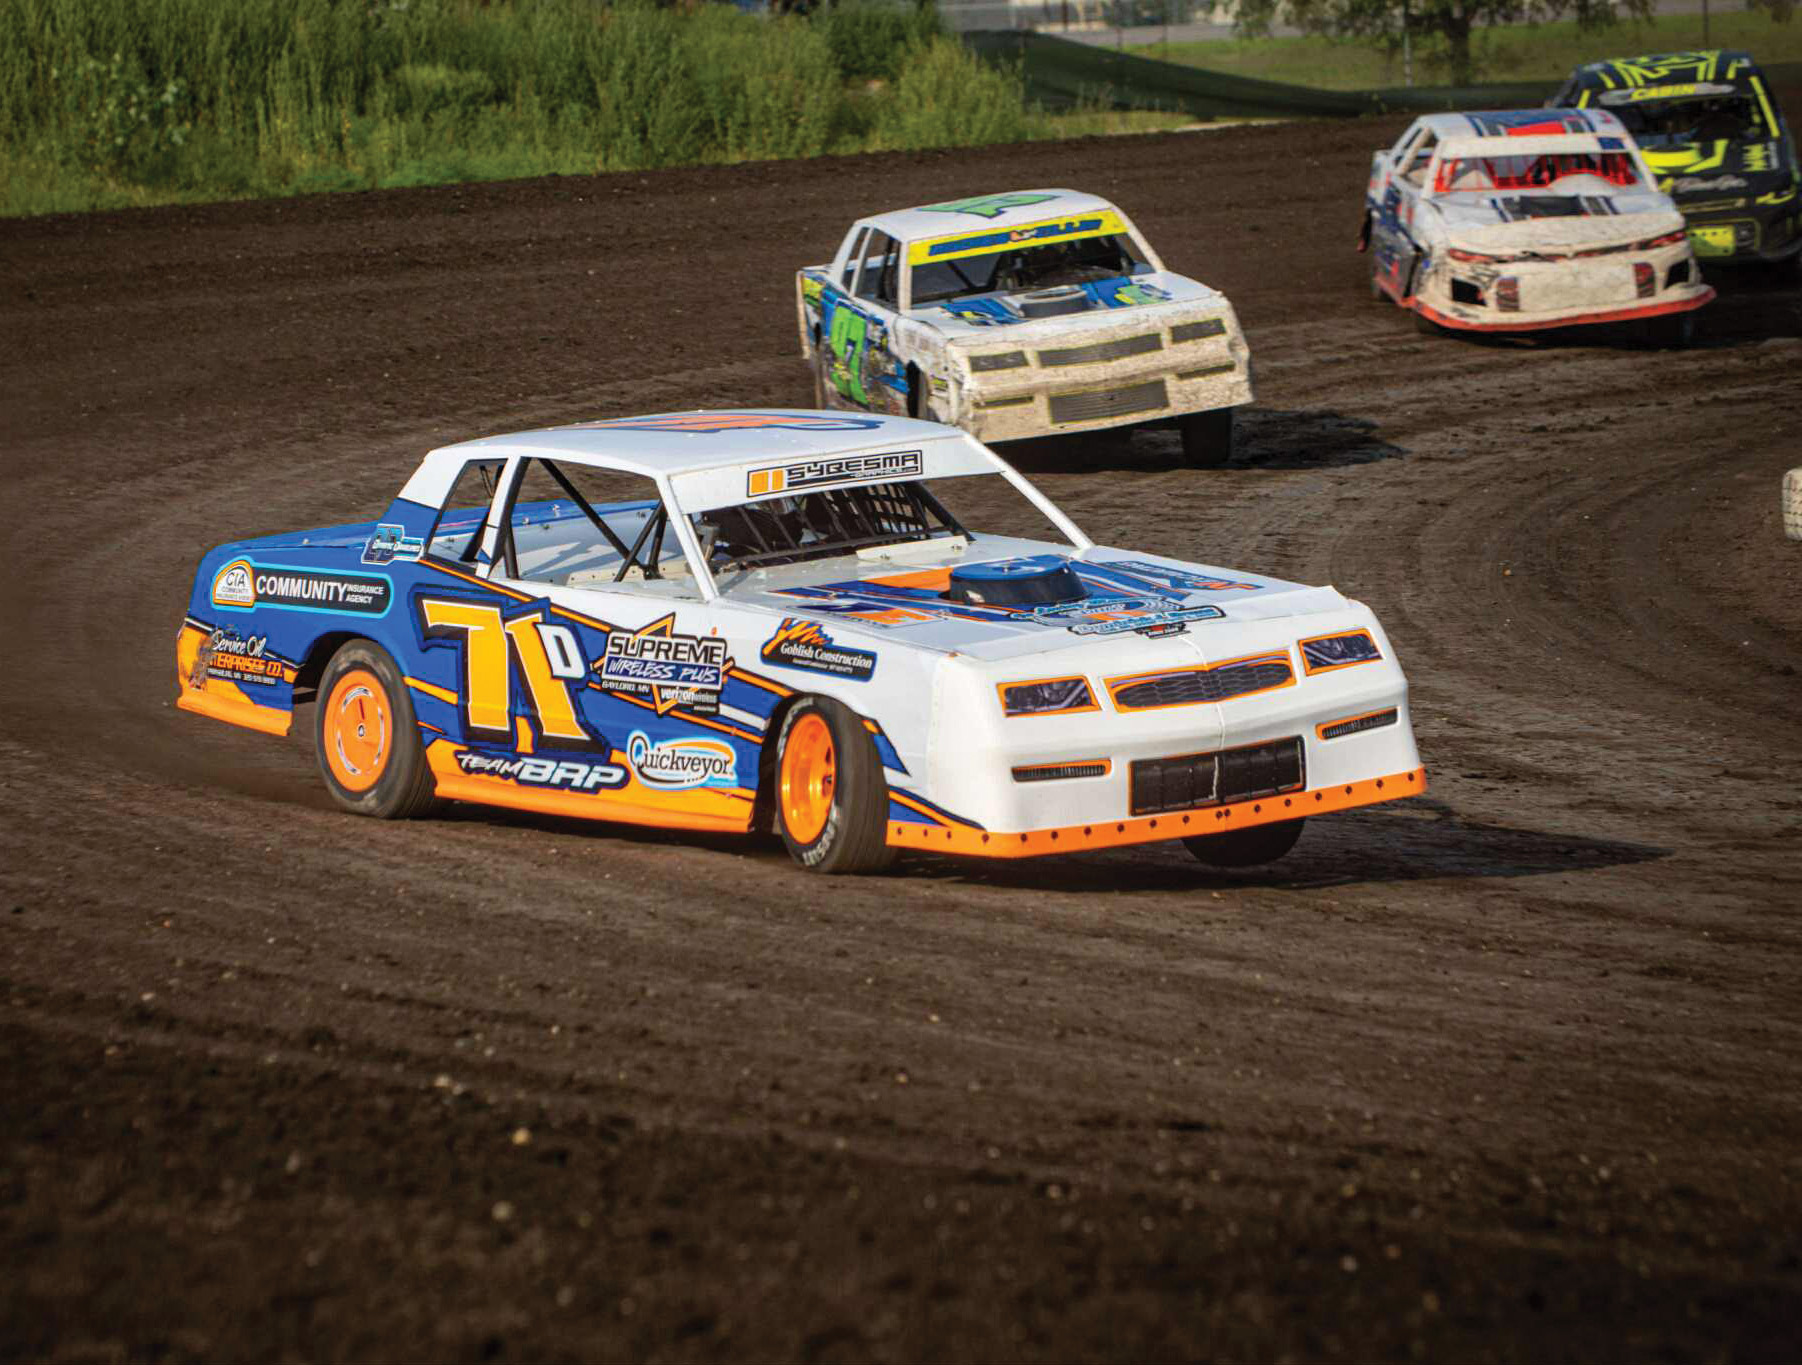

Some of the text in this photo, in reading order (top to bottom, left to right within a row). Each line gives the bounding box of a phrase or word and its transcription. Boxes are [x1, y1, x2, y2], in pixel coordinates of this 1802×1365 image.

[255, 575, 385, 604] COMMUNITY INSURANCE
[345, 594, 373, 604] AGENCY
[212, 629, 267, 657] Service Oil
[608, 635, 724, 665] SUPREME
[607, 659, 718, 682] WIRELESS PLUS
[815, 648, 873, 668] Construction
[456, 752, 626, 790] TEAM BRP
[630, 736, 731, 780] Quickveyor
